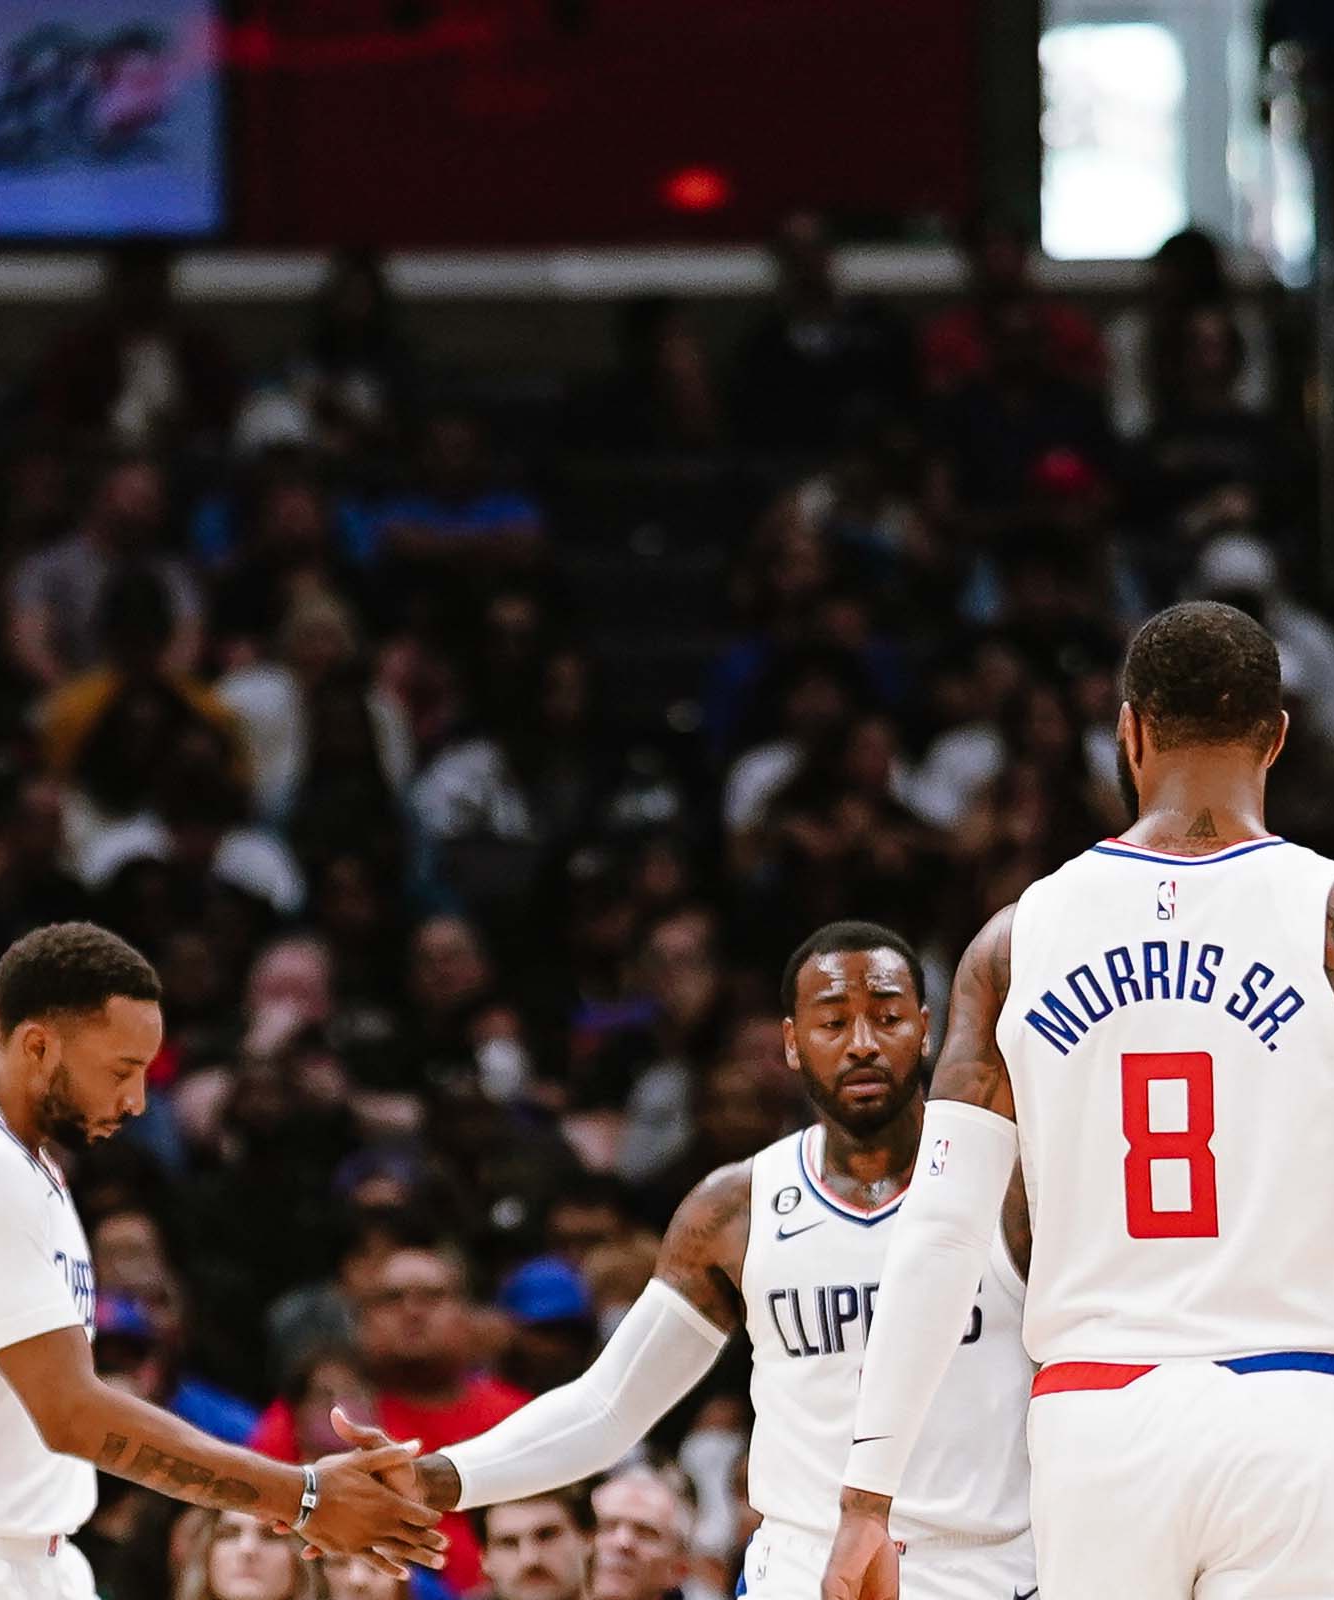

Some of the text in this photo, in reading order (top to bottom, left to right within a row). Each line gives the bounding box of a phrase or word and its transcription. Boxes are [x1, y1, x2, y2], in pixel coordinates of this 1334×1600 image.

[1024, 941, 1305, 1056] MORRIS SR.
[1121, 1051, 1219, 1239] 8
